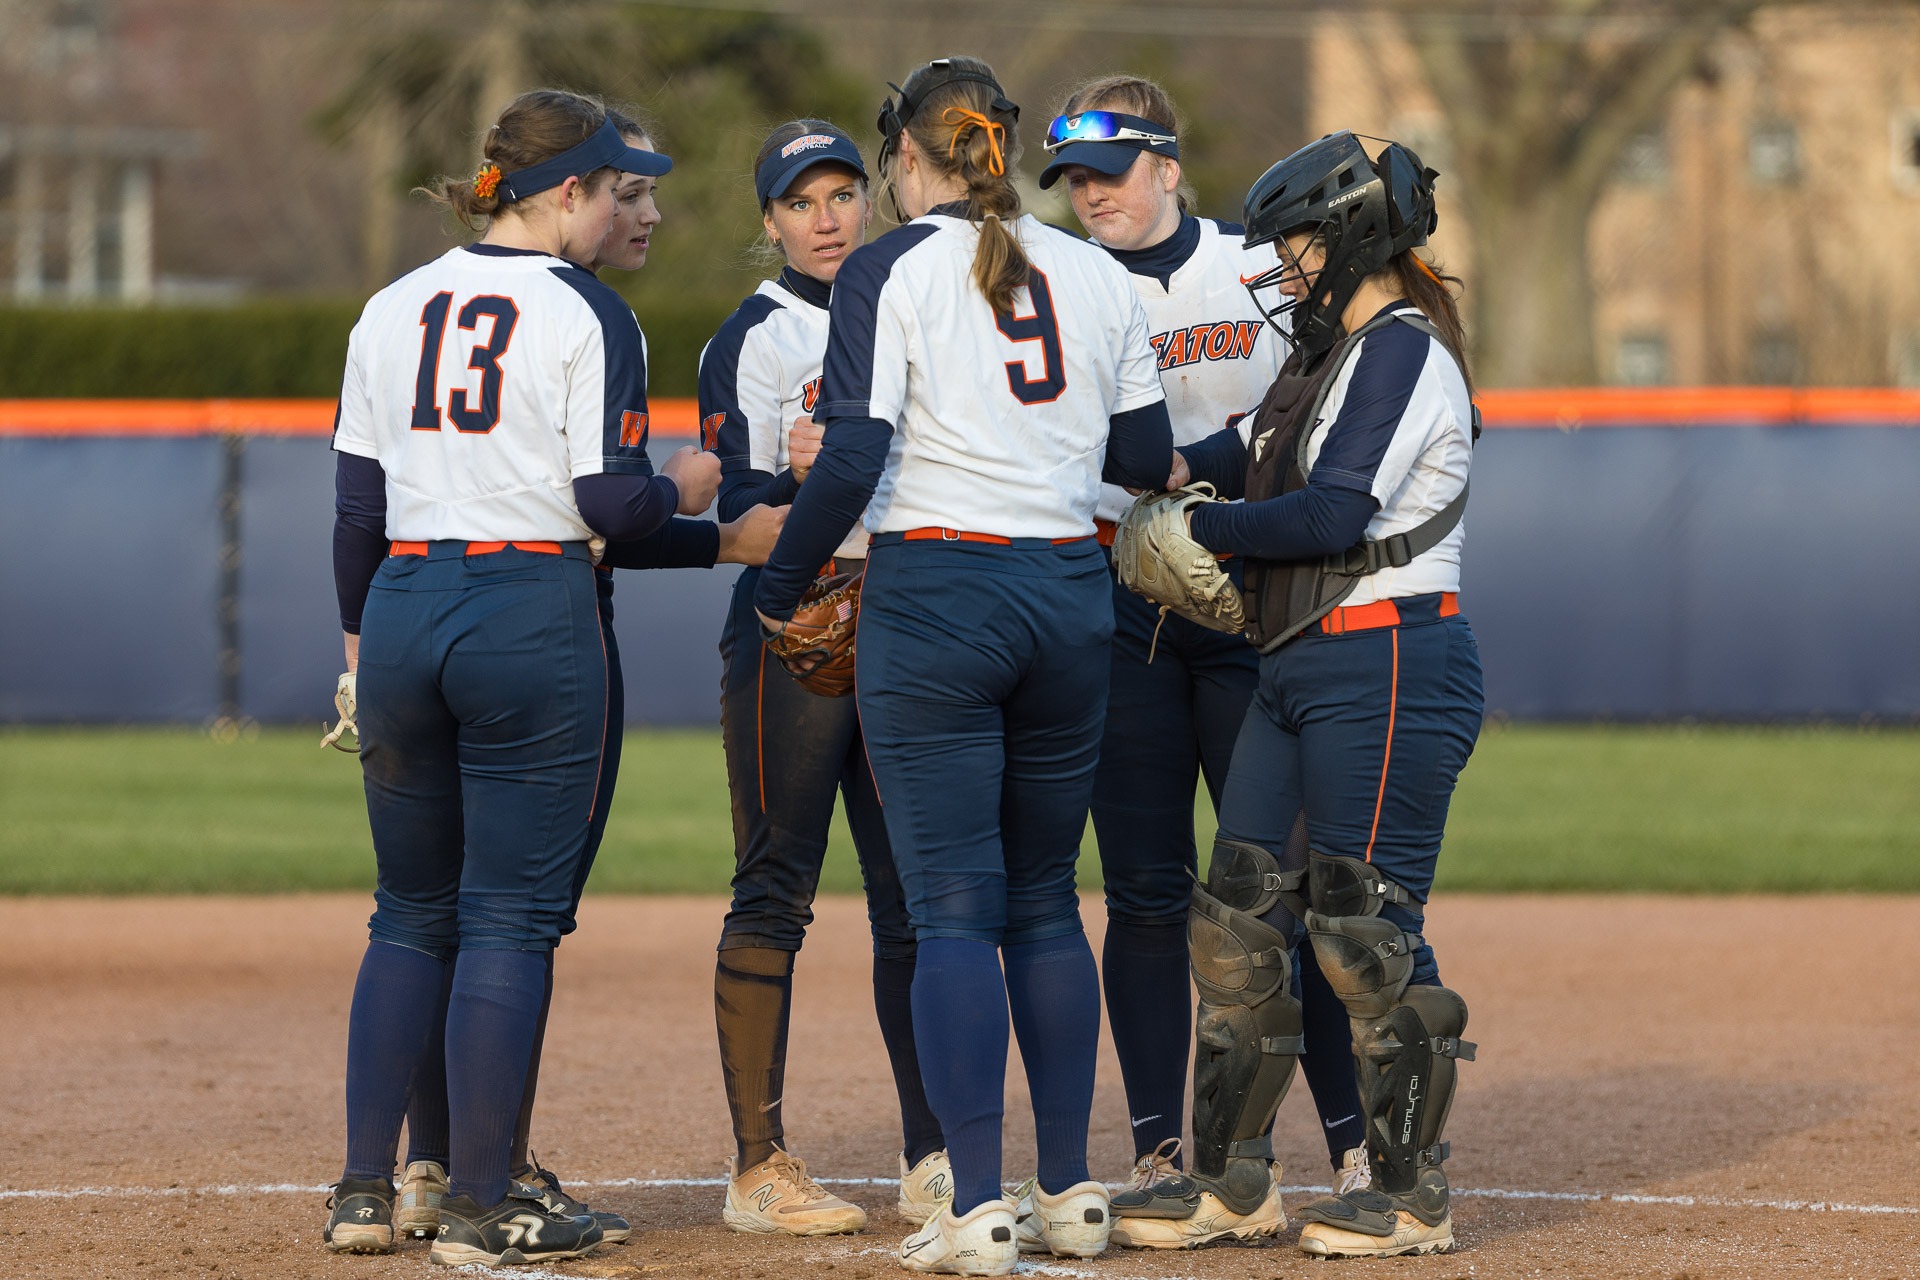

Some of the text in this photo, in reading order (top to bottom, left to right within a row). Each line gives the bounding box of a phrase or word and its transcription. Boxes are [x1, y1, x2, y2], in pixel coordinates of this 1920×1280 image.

[793, 143, 827, 155] SOFTBALL
[1328, 187, 1367, 208] EASTON
[991, 262, 1067, 406] 9
[410, 290, 520, 434] 13
[619, 409, 648, 447] W
